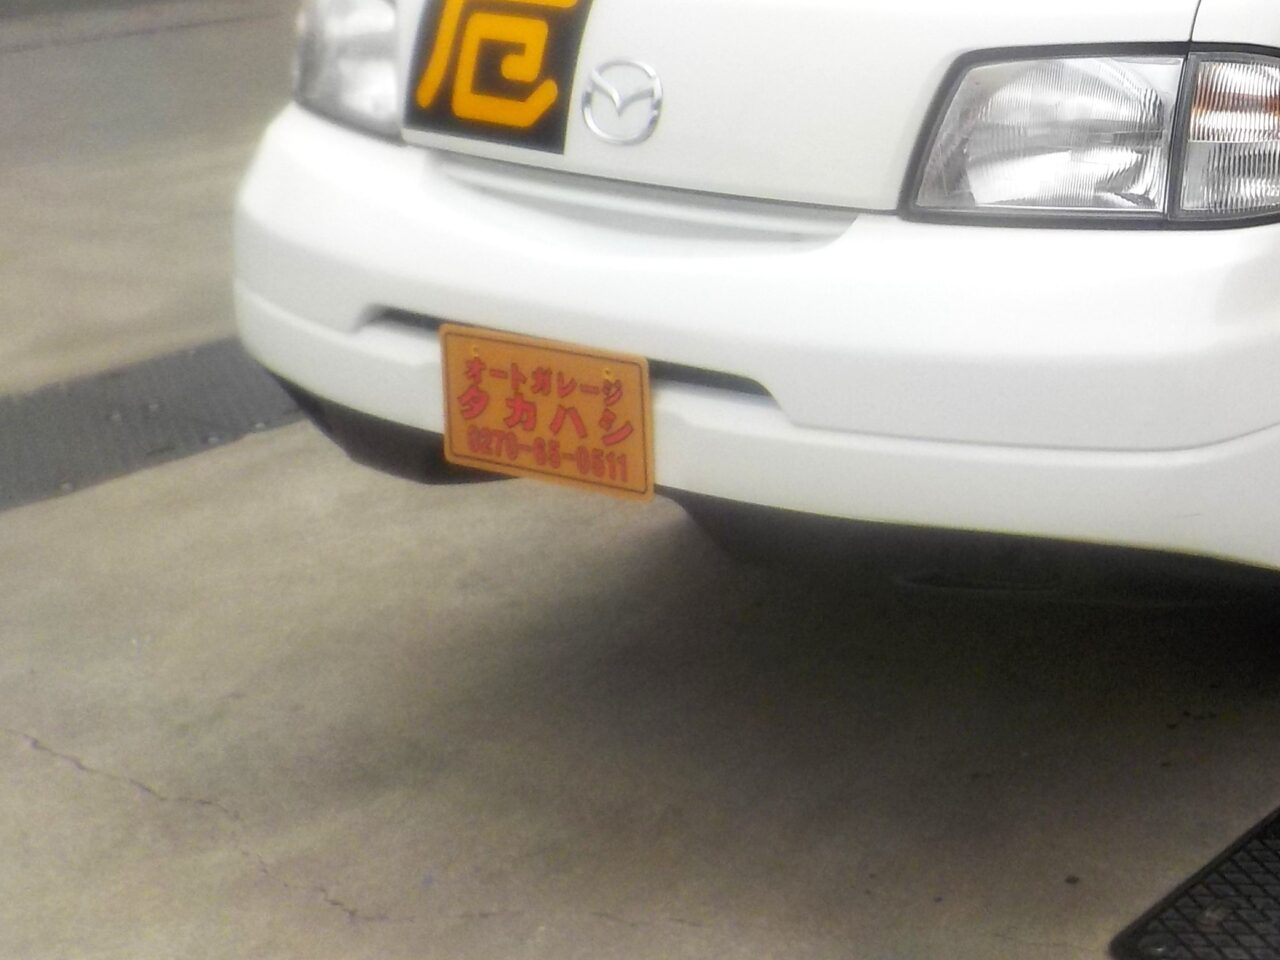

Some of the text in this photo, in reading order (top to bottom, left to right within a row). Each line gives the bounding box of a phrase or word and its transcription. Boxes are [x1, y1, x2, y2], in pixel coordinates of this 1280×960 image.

[463, 357, 623, 406] オートガレージ
[457, 384, 634, 446] タカハシ
